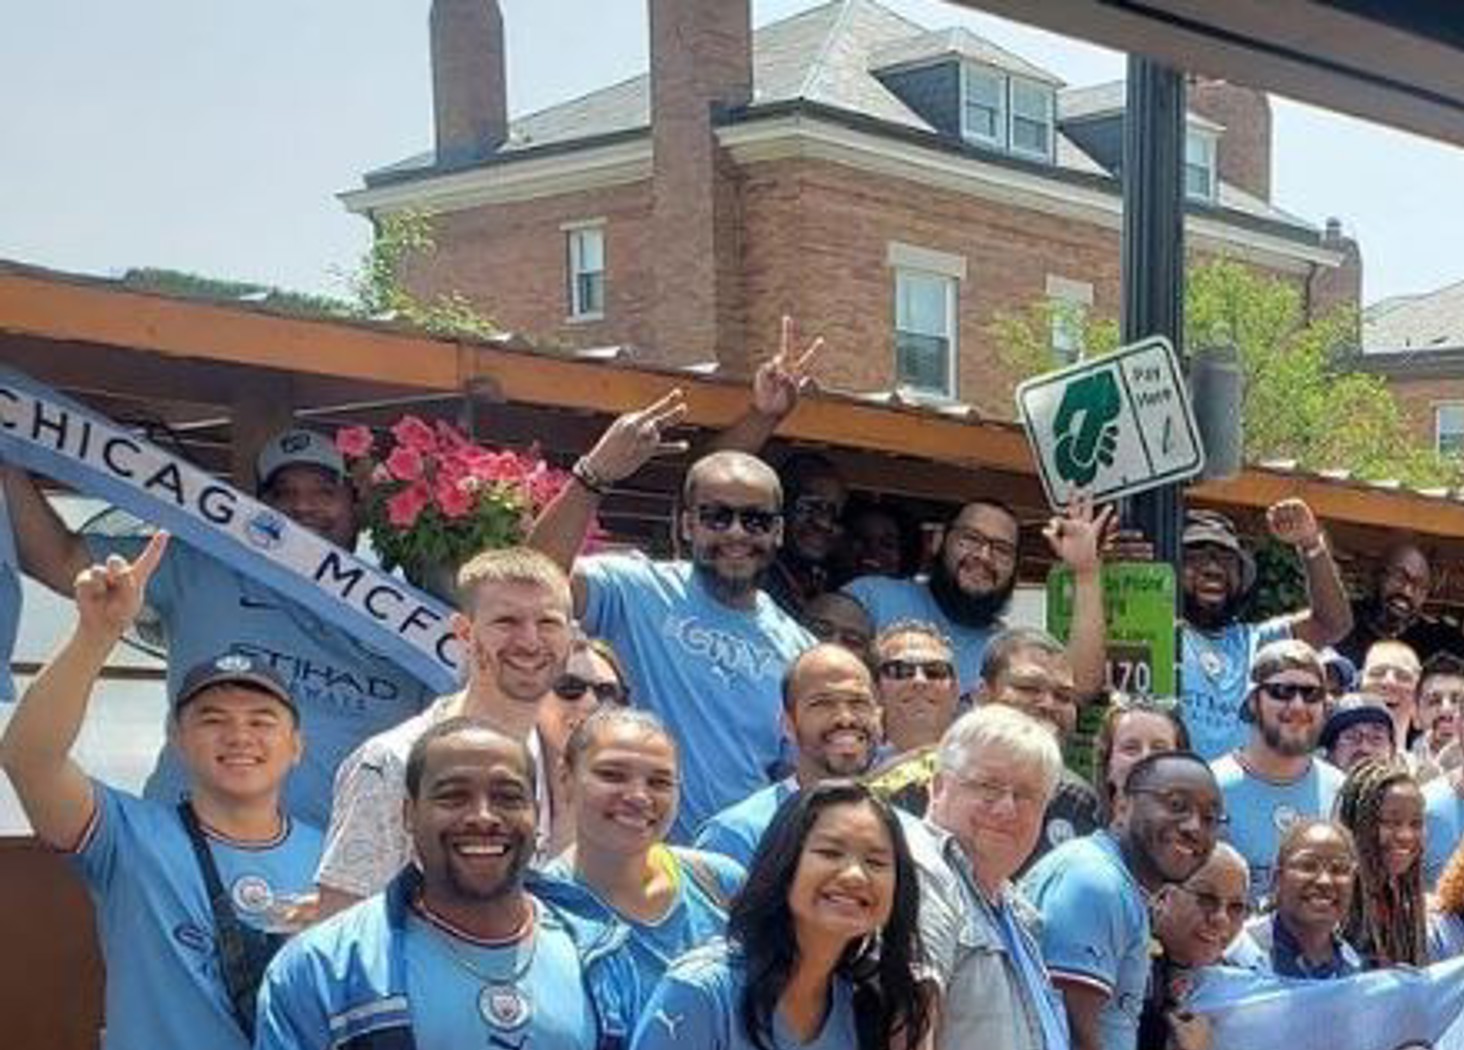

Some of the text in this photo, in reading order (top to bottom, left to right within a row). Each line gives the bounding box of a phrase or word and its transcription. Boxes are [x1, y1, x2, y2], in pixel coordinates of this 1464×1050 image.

[1132, 366, 1161, 383] Pay
[1136, 388, 1173, 408] Here
[314, 551, 459, 670] MCFC
